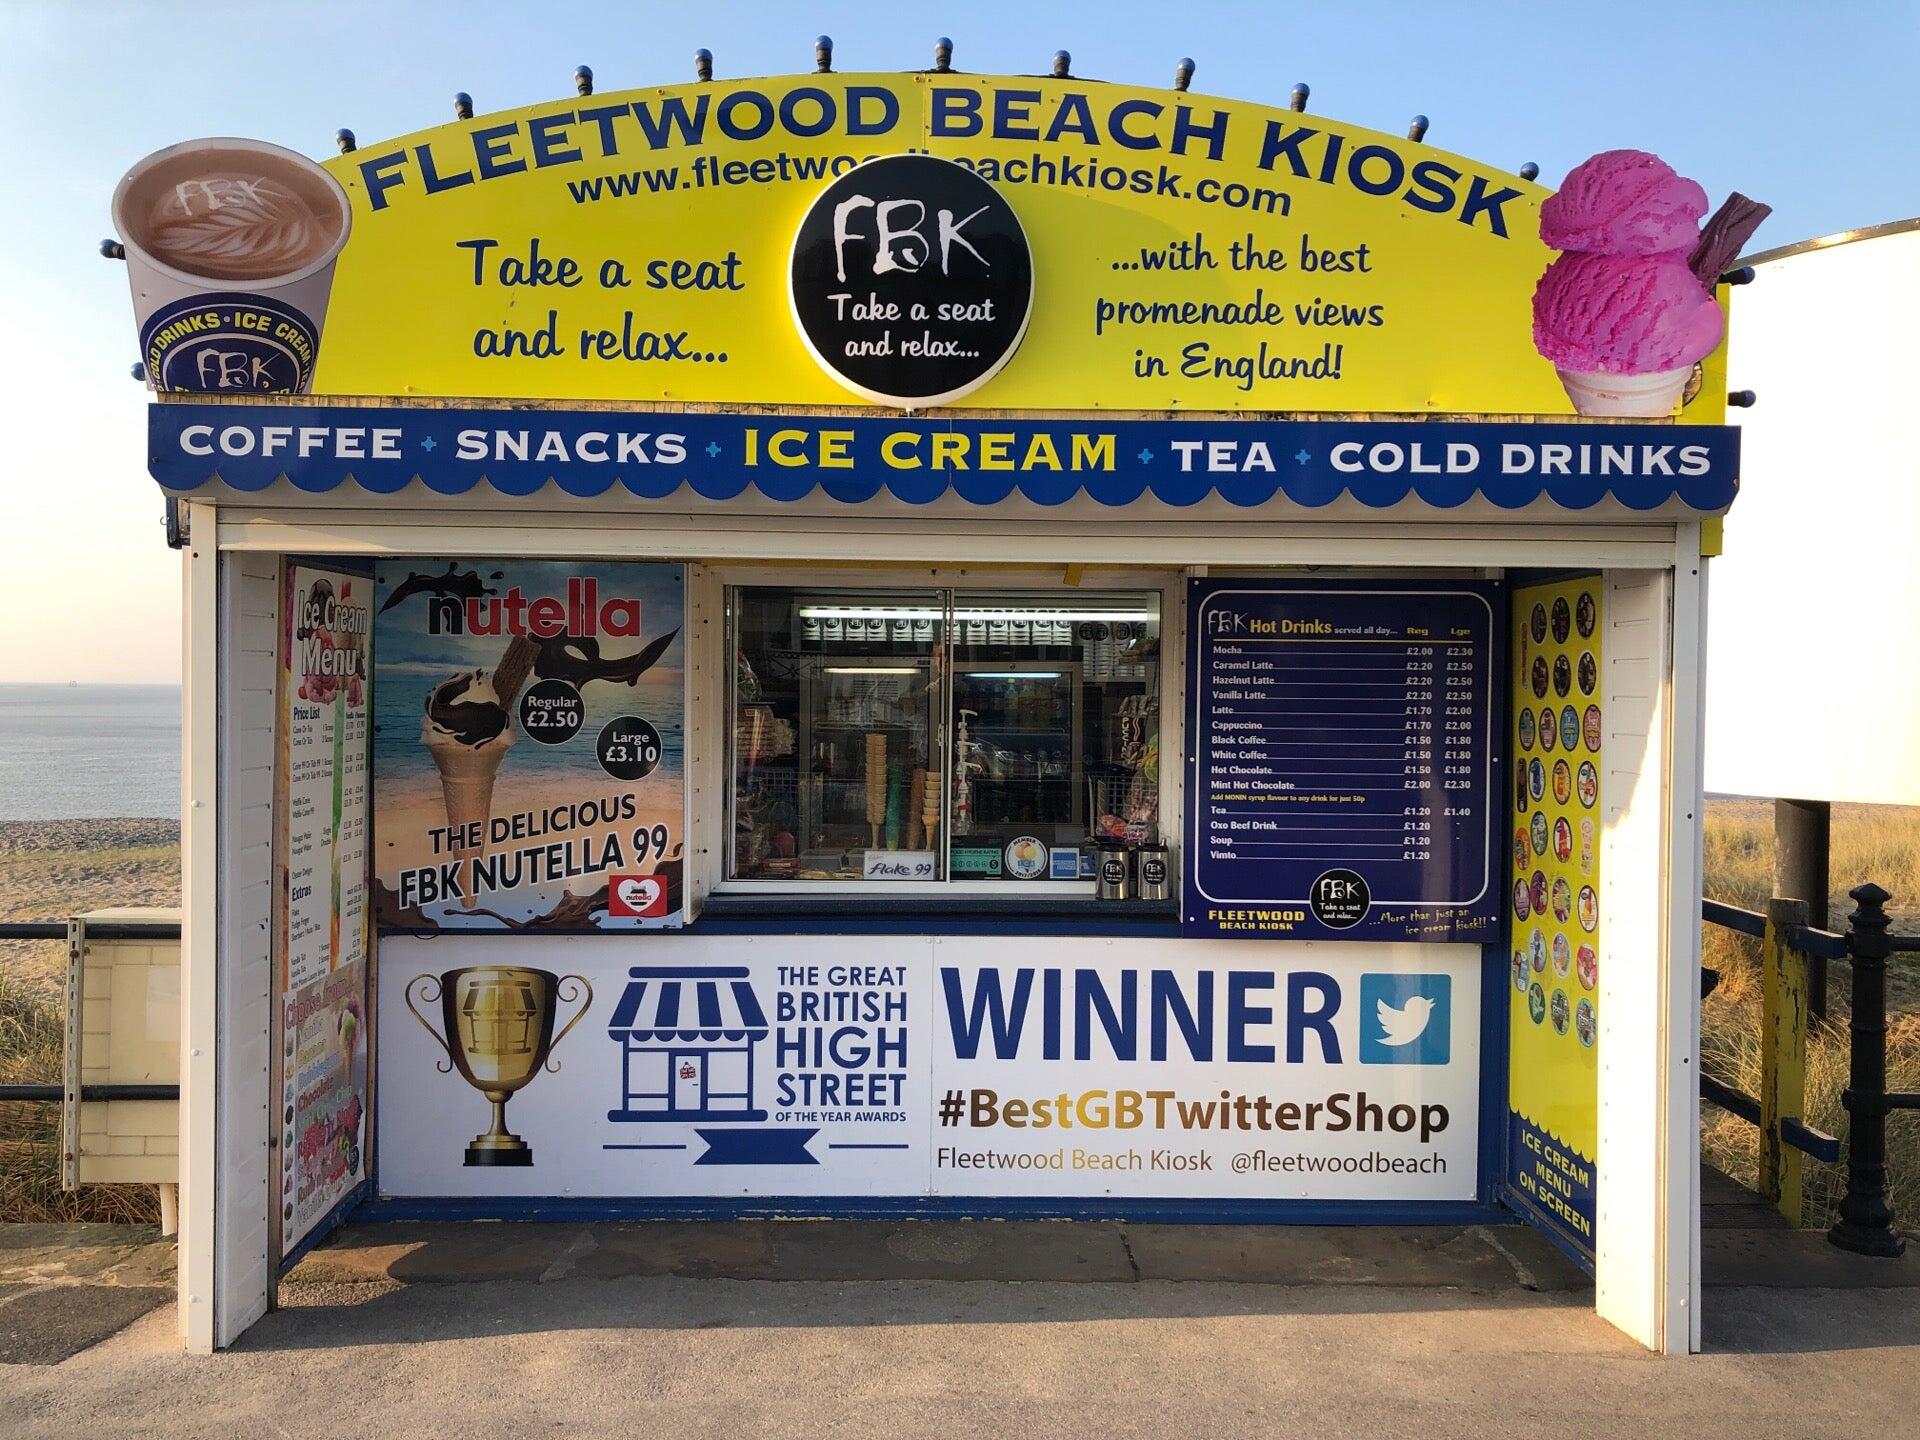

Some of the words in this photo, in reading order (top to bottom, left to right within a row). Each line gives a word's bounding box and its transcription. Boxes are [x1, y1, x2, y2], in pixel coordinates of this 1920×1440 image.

[357, 86, 900, 212] FLEETWOOD
[929, 88, 1232, 161] BEACH
[1256, 120, 1525, 240] KIOSK
[833, 194, 990, 283] FBK
[1111, 234, 1218, 271] ...with
[1230, 233, 1287, 271] the
[1301, 233, 1372, 273] best
[455, 239, 582, 287] Take
[599, 262, 631, 287] a
[646, 251, 745, 291] seat
[827, 293, 901, 322] Take
[910, 303, 930, 321] a
[938, 298, 996, 322] seat
[1096, 288, 1285, 335] promenade
[1295, 298, 1384, 327] views
[154, 312, 221, 351] DRINKS
[234, 311, 272, 332] ICE
[275, 322, 311, 365] CREAM
[473, 311, 564, 361] and
[580, 315, 729, 364] relax...
[845, 331, 893, 357] and
[900, 333, 980, 358] relax...
[196, 347, 281, 388] FBK
[1135, 348, 1168, 378] in
[1181, 342, 1342, 391] England!
[179, 425, 402, 459] COFFEE
[455, 429, 687, 464] SNACKS
[744, 429, 855, 469] ICE
[881, 432, 1116, 472] CREAM
[1171, 440, 1276, 474] TEA
[1330, 441, 1480, 475] COLD
[1502, 444, 1711, 477] DRINKS
[298, 589, 320, 633] Ice
[324, 599, 368, 637] Cream
[428, 576, 641, 638] nutella
[1207, 609, 1248, 635] FBK
[1250, 619, 1277, 633] Hot
[1281, 618, 1332, 634] Drinks
[1334, 626, 1361, 634] served
[1364, 626, 1374, 634] all
[1407, 627, 1428, 636] Reg
[1450, 627, 1470, 636] Lge
[302, 637, 358, 676] Menu
[1213, 645, 1242, 654] Mocha
[1407, 647, 1433, 656] £2.00
[1446, 647, 1473, 656] £2.30
[1213, 660, 1250, 670] Caramel
[1252, 661, 1274, 670] Latte
[1406, 662, 1433, 671] £2.20
[1446, 662, 1473, 671] £2.50
[1212, 676, 1251, 685] Hazelnut
[1253, 676, 1275, 685] Latte
[1406, 677, 1432, 685] £2.20
[1446, 677, 1473, 685] £2.50
[527, 695, 578, 710] Regular
[1212, 691, 1242, 699] Vanilla
[1244, 691, 1266, 700] Latte
[1405, 691, 1432, 700] £2.20
[1445, 691, 1472, 700] £2.50
[293, 706, 308, 721] Price
[310, 706, 320, 720] List
[526, 710, 578, 729] £2.50
[1212, 706, 1234, 714] Latte
[1405, 706, 1432, 715] £1.70
[1445, 706, 1472, 715] £2.00
[1211, 721, 1263, 731] Cappuccino
[1405, 721, 1432, 730] £1.70
[1445, 721, 1472, 730] £2.00
[612, 731, 650, 746] Large
[1211, 735, 1236, 744] Black
[1238, 735, 1267, 744] Coffee
[1404, 736, 1431, 745] £1.50
[1444, 736, 1472, 745] £1.80
[605, 745, 657, 763] £3.10
[1211, 750, 1237, 759] White
[1239, 750, 1268, 759] Coffee
[1404, 751, 1431, 759] £1.50
[1444, 751, 1471, 759] £1.80
[1211, 766, 1227, 774] Hot
[1229, 766, 1273, 774] Chocolate
[1404, 766, 1431, 774] £1.50
[1444, 766, 1471, 774] £1.80
[1210, 780, 1231, 789] Mint
[1233, 780, 1249, 789] Hot
[1251, 780, 1295, 790] Chocolate
[1404, 780, 1431, 789] £2.00
[1444, 780, 1471, 789] £2.30
[1248, 795, 1266, 803] syrup
[1211, 806, 1226, 814] Tea
[1403, 807, 1431, 816] £1.20
[1443, 807, 1471, 816] £1.40
[428, 820, 483, 855] THE
[489, 794, 637, 845] DELICIOUS
[1210, 821, 1228, 829] Oxo
[1230, 821, 1251, 829] Beef
[1252, 821, 1278, 830] Drink
[1403, 822, 1431, 831] £1.20
[1210, 836, 1233, 846] Soup
[1403, 837, 1431, 845] £1.20
[1210, 850, 1237, 859] Vimto
[1403, 851, 1430, 860] £1.20
[399, 857, 466, 910] FBK
[471, 832, 626, 899] NUTELLA
[631, 823, 670, 866] 99
[914, 863, 932, 876] 99
[292, 885, 312, 901] Extras
[1320, 878, 1360, 900] FBK
[1208, 910, 1305, 921] FLEETWOOD
[1318, 902, 1338, 911] Take
[1410, 909, 1430, 922] than
[1435, 909, 1454, 922] just
[1219, 922, 1256, 930] BEACH
[1259, 922, 1294, 930] KIOSK
[1405, 925, 1419, 935] ice
[1424, 924, 1451, 933] cream
[777, 966, 819, 986] THE
[827, 966, 907, 986] GREAT
[777, 991, 907, 1022] BRITISH
[940, 966, 1343, 1065] WINNER
[776, 1026, 907, 1069] HIGH
[776, 1072, 907, 1107] STREET
[775, 1111, 792, 1122] OF
[794, 1111, 818, 1122] THE
[820, 1111, 851, 1122] YEAR
[854, 1111, 907, 1122] AWARDS
[938, 1089, 1450, 1143] #BestGBTwitterShop
[937, 1148, 1065, 1170] Fleetwood
[1072, 1149, 1142, 1171] Beach
[1151, 1149, 1212, 1171] Kiosk
[1230, 1150, 1447, 1175] @fleetwoodbeach
[1522, 1129, 1541, 1155] ICE
[1544, 1145, 1589, 1188] CREAM
[1536, 1160, 1572, 1198] MENU
[1519, 1171, 1536, 1195] ON
[1538, 1185, 1591, 1237] SCREEN
